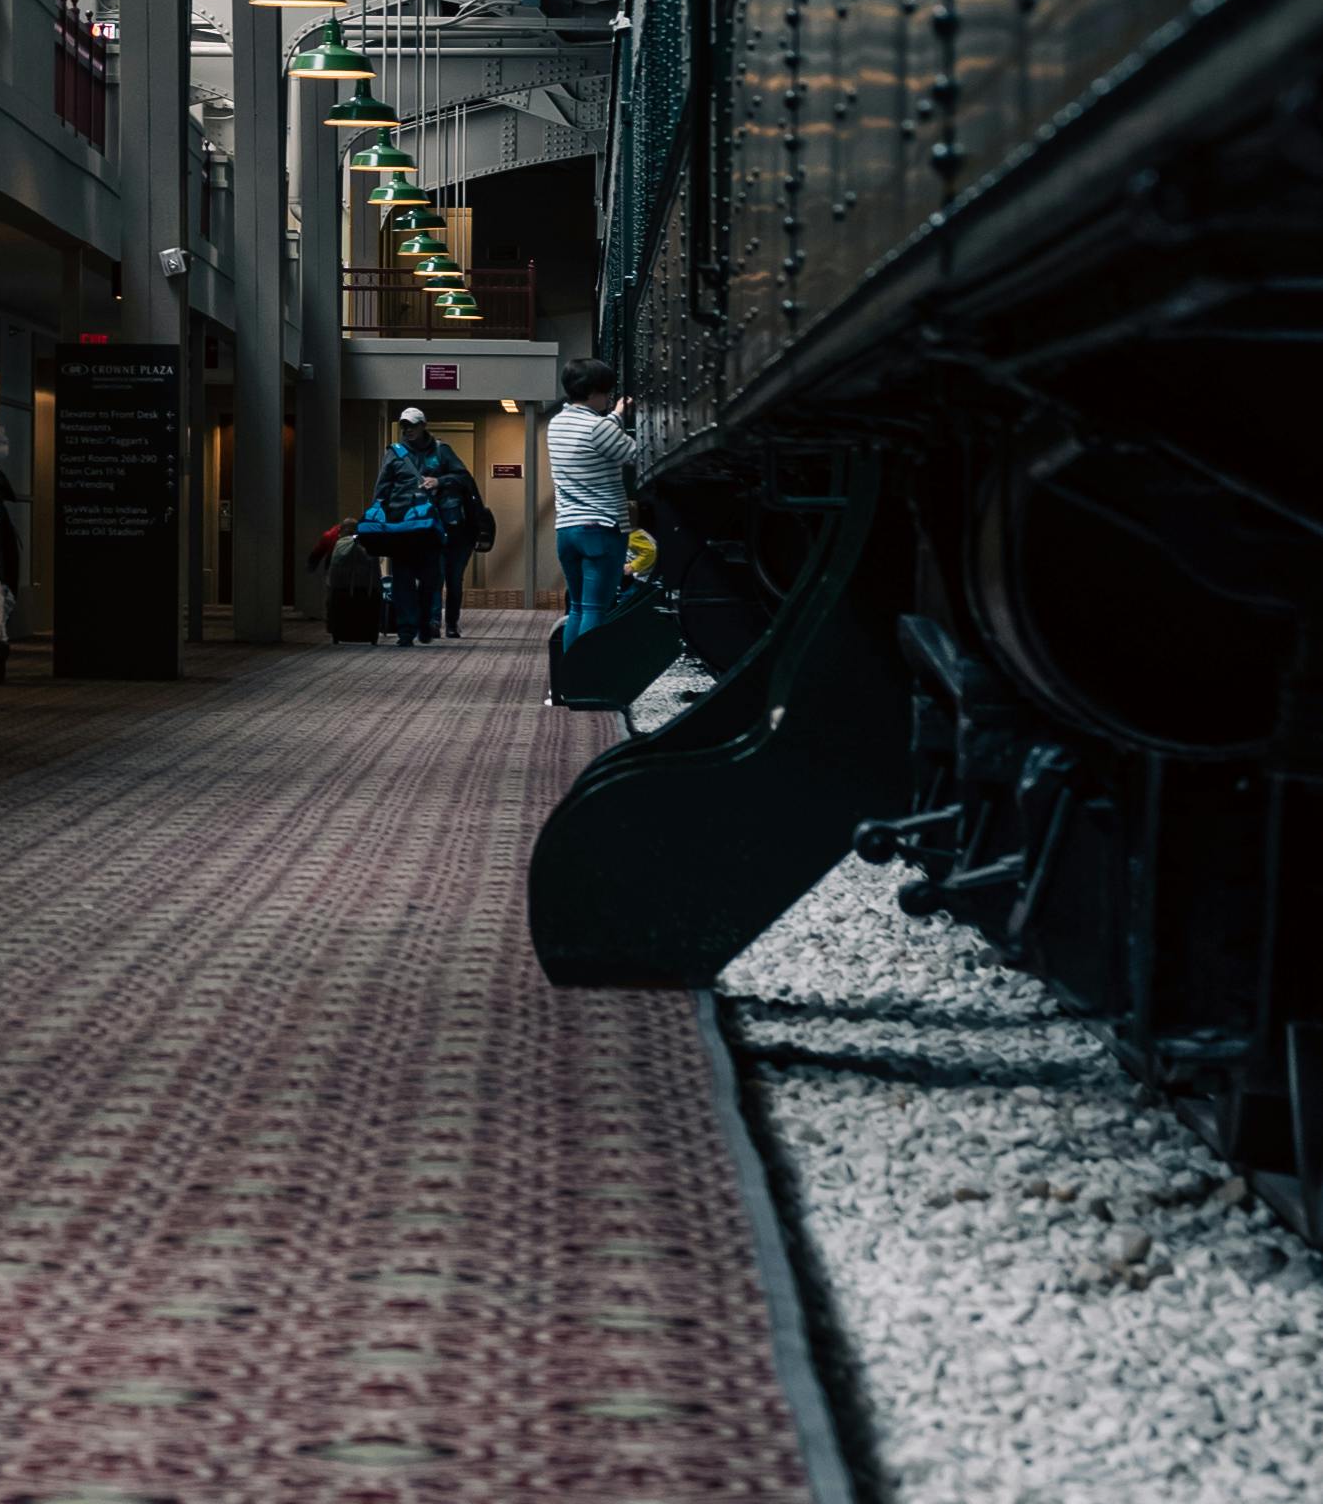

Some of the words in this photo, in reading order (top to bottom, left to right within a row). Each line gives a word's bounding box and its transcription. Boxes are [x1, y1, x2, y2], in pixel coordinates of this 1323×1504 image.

[91, 365, 136, 375] CROWNE
[140, 365, 175, 375] PLAZA
[137, 410, 159, 419] Desk
[60, 454, 85, 463] Guest
[66, 527, 90, 536] Lucas
[92, 527, 106, 536] Oil
[108, 527, 145, 536] Stadium
